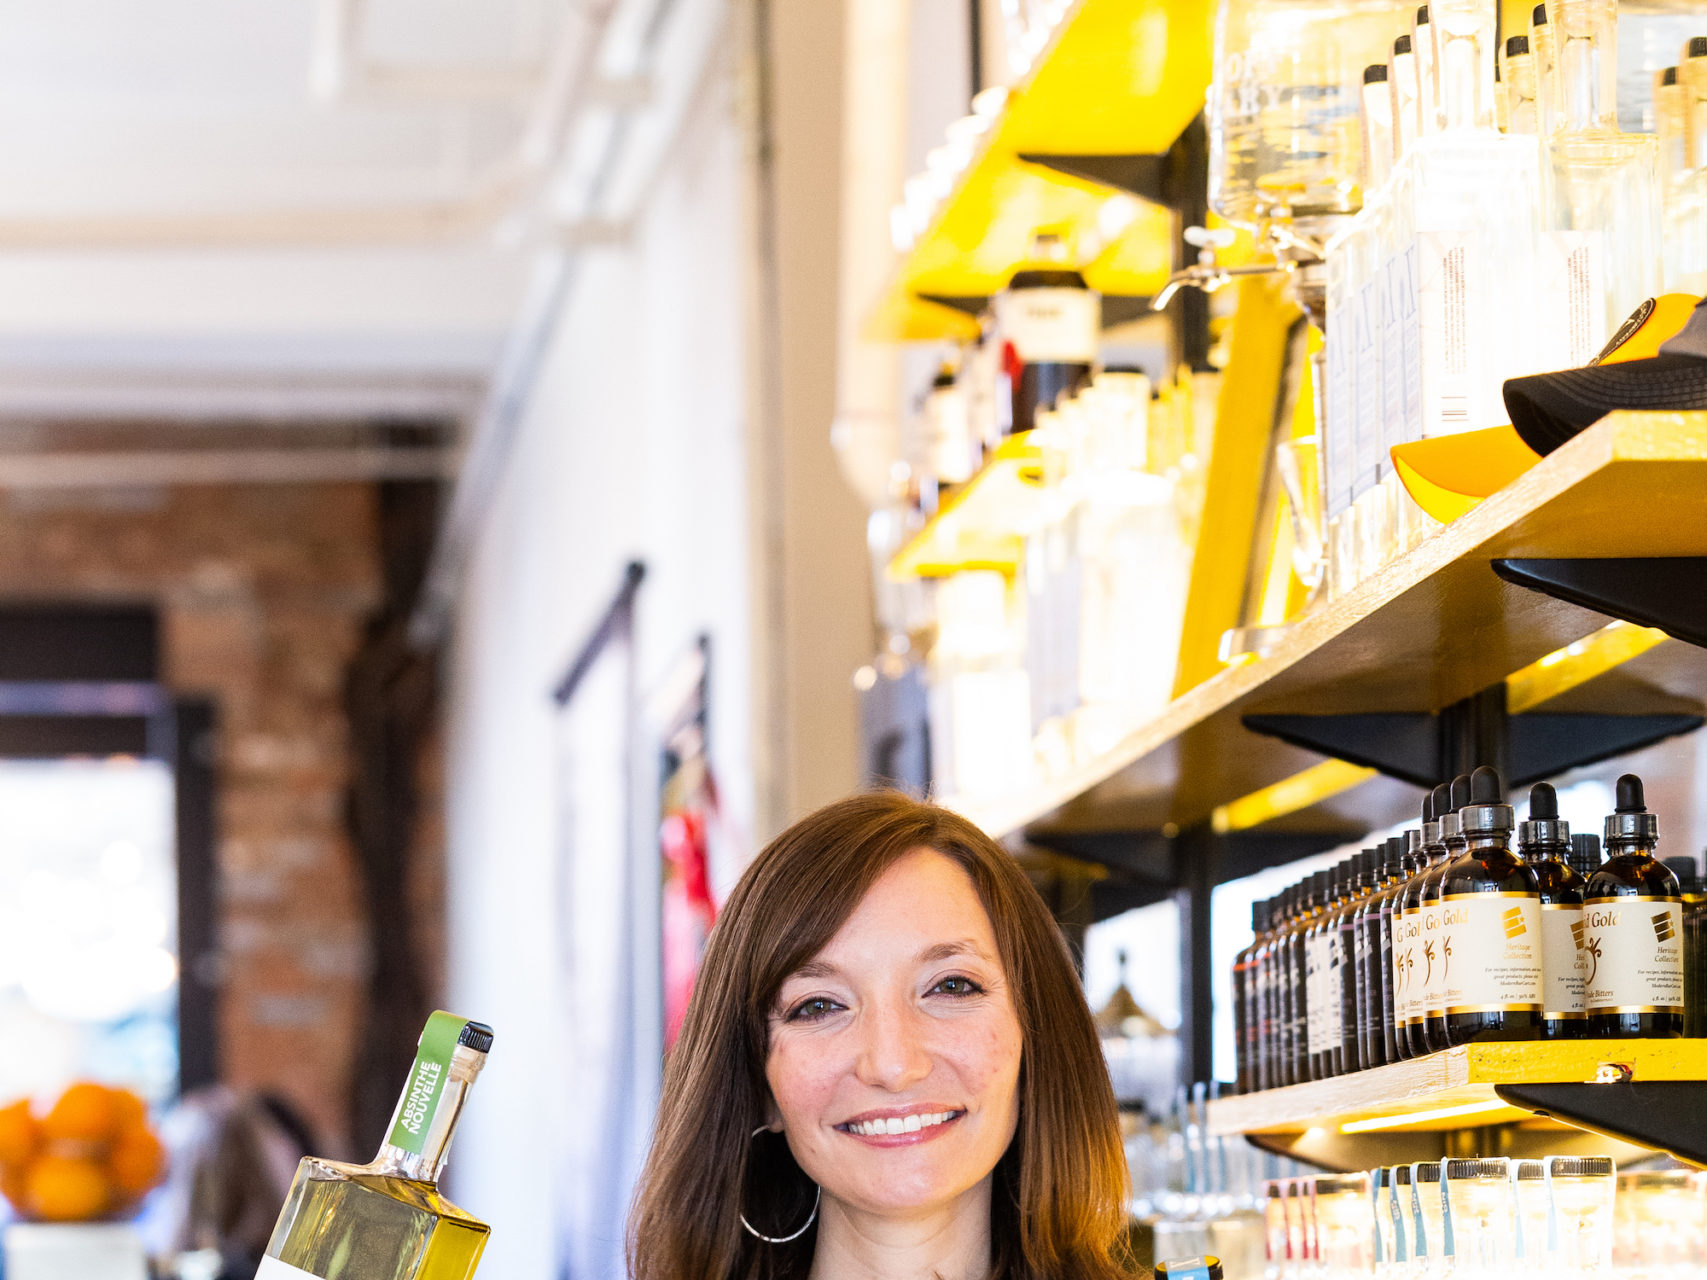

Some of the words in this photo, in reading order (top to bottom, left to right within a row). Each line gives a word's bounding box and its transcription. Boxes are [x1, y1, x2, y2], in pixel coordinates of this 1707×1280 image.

[1592, 911, 1621, 928] Gold
[401, 1061, 431, 1129] ABSINTHE
[408, 1062, 442, 1135] NOUVELLE
